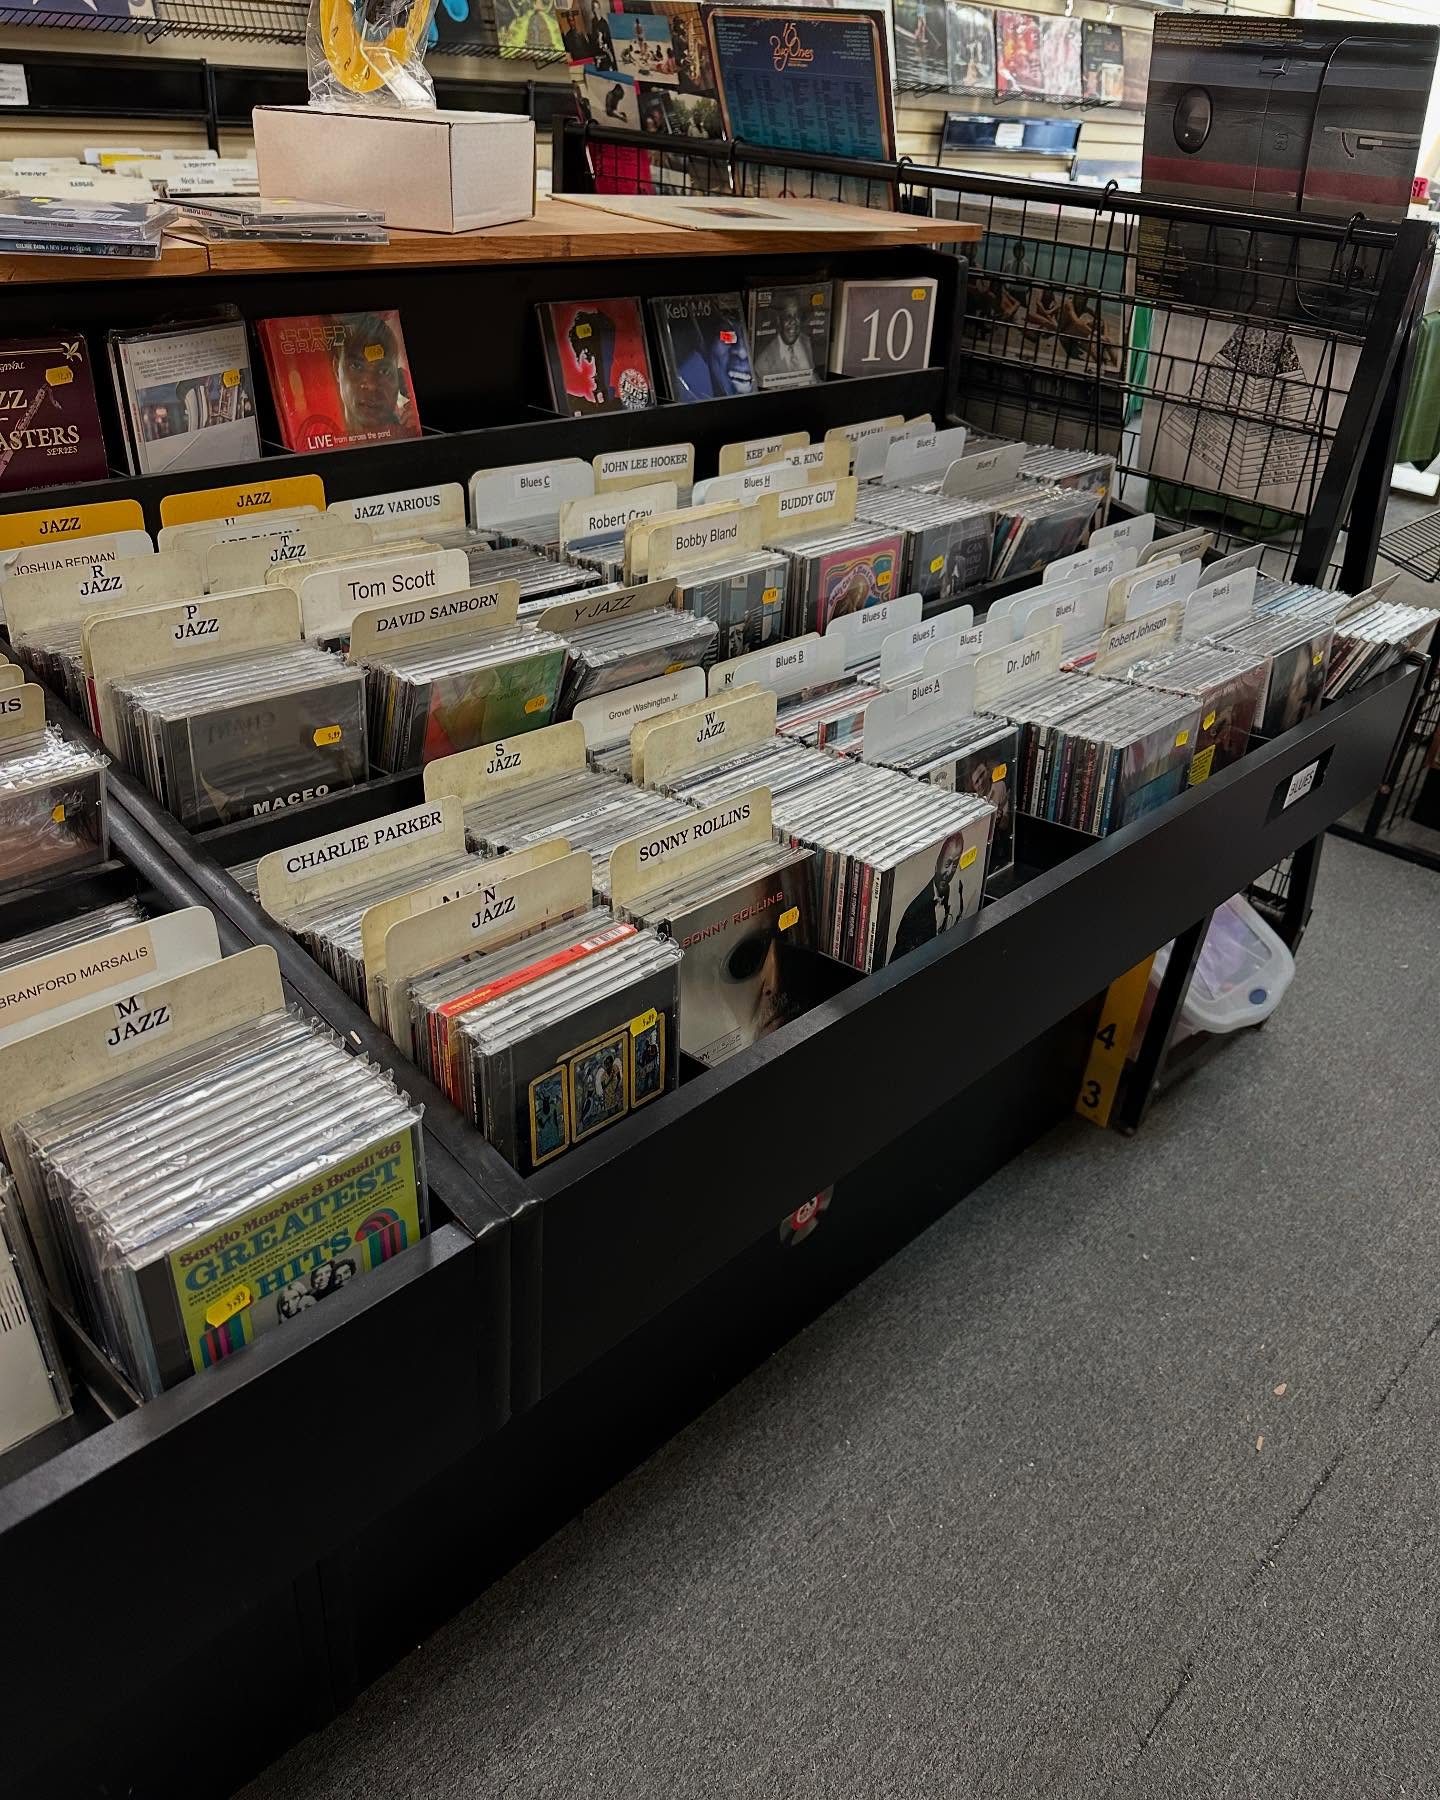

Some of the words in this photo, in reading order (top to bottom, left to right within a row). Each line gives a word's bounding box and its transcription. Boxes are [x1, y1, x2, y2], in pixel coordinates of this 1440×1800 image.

[861, 308, 914, 362] 10
[280, 338, 334, 355] CRAY
[46, 446, 78, 456] SERIES
[308, 434, 334, 449] LIVE
[916, 438, 932, 448] Blues
[602, 460, 629, 475] JOHN
[630, 457, 649, 472] LEE
[650, 452, 688, 470] HOOKER
[803, 451, 824, 465] KING
[520, 474, 543, 489] Blues
[744, 478, 764, 489] Blues
[764, 475, 771, 488] H
[236, 491, 272, 508] JAZZ
[354, 504, 385, 520] JAZZ
[387, 495, 441, 514] VARIOUS
[780, 495, 815, 512] BUDDY
[816, 489, 836, 505] GUY
[39, 517, 82, 535] JAZZ
[588, 512, 627, 531] Robert
[280, 535, 290, 548] T
[676, 534, 708, 550] Bobby
[709, 525, 738, 543] Bland
[14, 560, 63, 576] JOSHUA
[65, 551, 116, 568] REDMAN
[270, 544, 307, 562] JAZZ
[92, 565, 104, 578] R
[1093, 564, 1108, 576] Blues
[80, 577, 123, 596] JAZZ
[347, 579, 386, 601] Tom
[391, 569, 437, 593] Scott
[1155, 577, 1171, 590] Blues
[186, 605, 198, 620] P
[376, 609, 426, 633] DAVID
[428, 592, 500, 620] SANBORN
[573, 607, 584, 623] Y
[586, 594, 636, 619] JAZZ
[862, 612, 881, 624] Blues
[881, 608, 888, 621] G
[1056, 603, 1072, 618] Blues
[174, 619, 220, 640] JAZZ
[912, 629, 930, 644] Blues
[960, 634, 977, 646] Blues
[1108, 630, 1136, 651] Robert
[1134, 616, 1168, 640] Johnson
[775, 653, 797, 669] Blues
[797, 650, 804, 664] B
[1007, 659, 1020, 675] Dr.
[1019, 649, 1041, 669] John
[911, 683, 934, 701] Blues
[934, 680, 941, 695] A
[608, 704, 633, 721] Grover
[633, 695, 670, 715] Washington
[704, 711, 715, 725] W
[696, 721, 725, 744] JAZZ
[495, 744, 505, 758] S
[486, 754, 522, 775] JAZZ
[1289, 770, 1314, 796] BLUES
[252, 784, 330, 817] MACEO
[286, 835, 369, 874] CHARLIE
[374, 811, 442, 846] PARKER
[639, 829, 690, 863] SONNY
[692, 804, 752, 839] ROLLINS
[484, 886, 497, 904] N
[471, 896, 516, 930] JAZZ
[681, 920, 729, 949] SONNY
[732, 891, 784, 926] ROLLINS
[0, 971, 77, 1010] BRANFORD
[79, 946, 149, 978] MARSALIS
[115, 996, 140, 1020] M
[107, 1006, 171, 1046] JAZZ
[1096, 1023, 1116, 1050] 4
[1080, 1080, 1101, 1108] 3
[179, 1230, 241, 1267] Sergio
[242, 1194, 310, 1234] Mendes
[326, 1156, 375, 1190] Brasil
[185, 1155, 402, 1291] GREATEST
[255, 1228, 353, 1300] HITS
